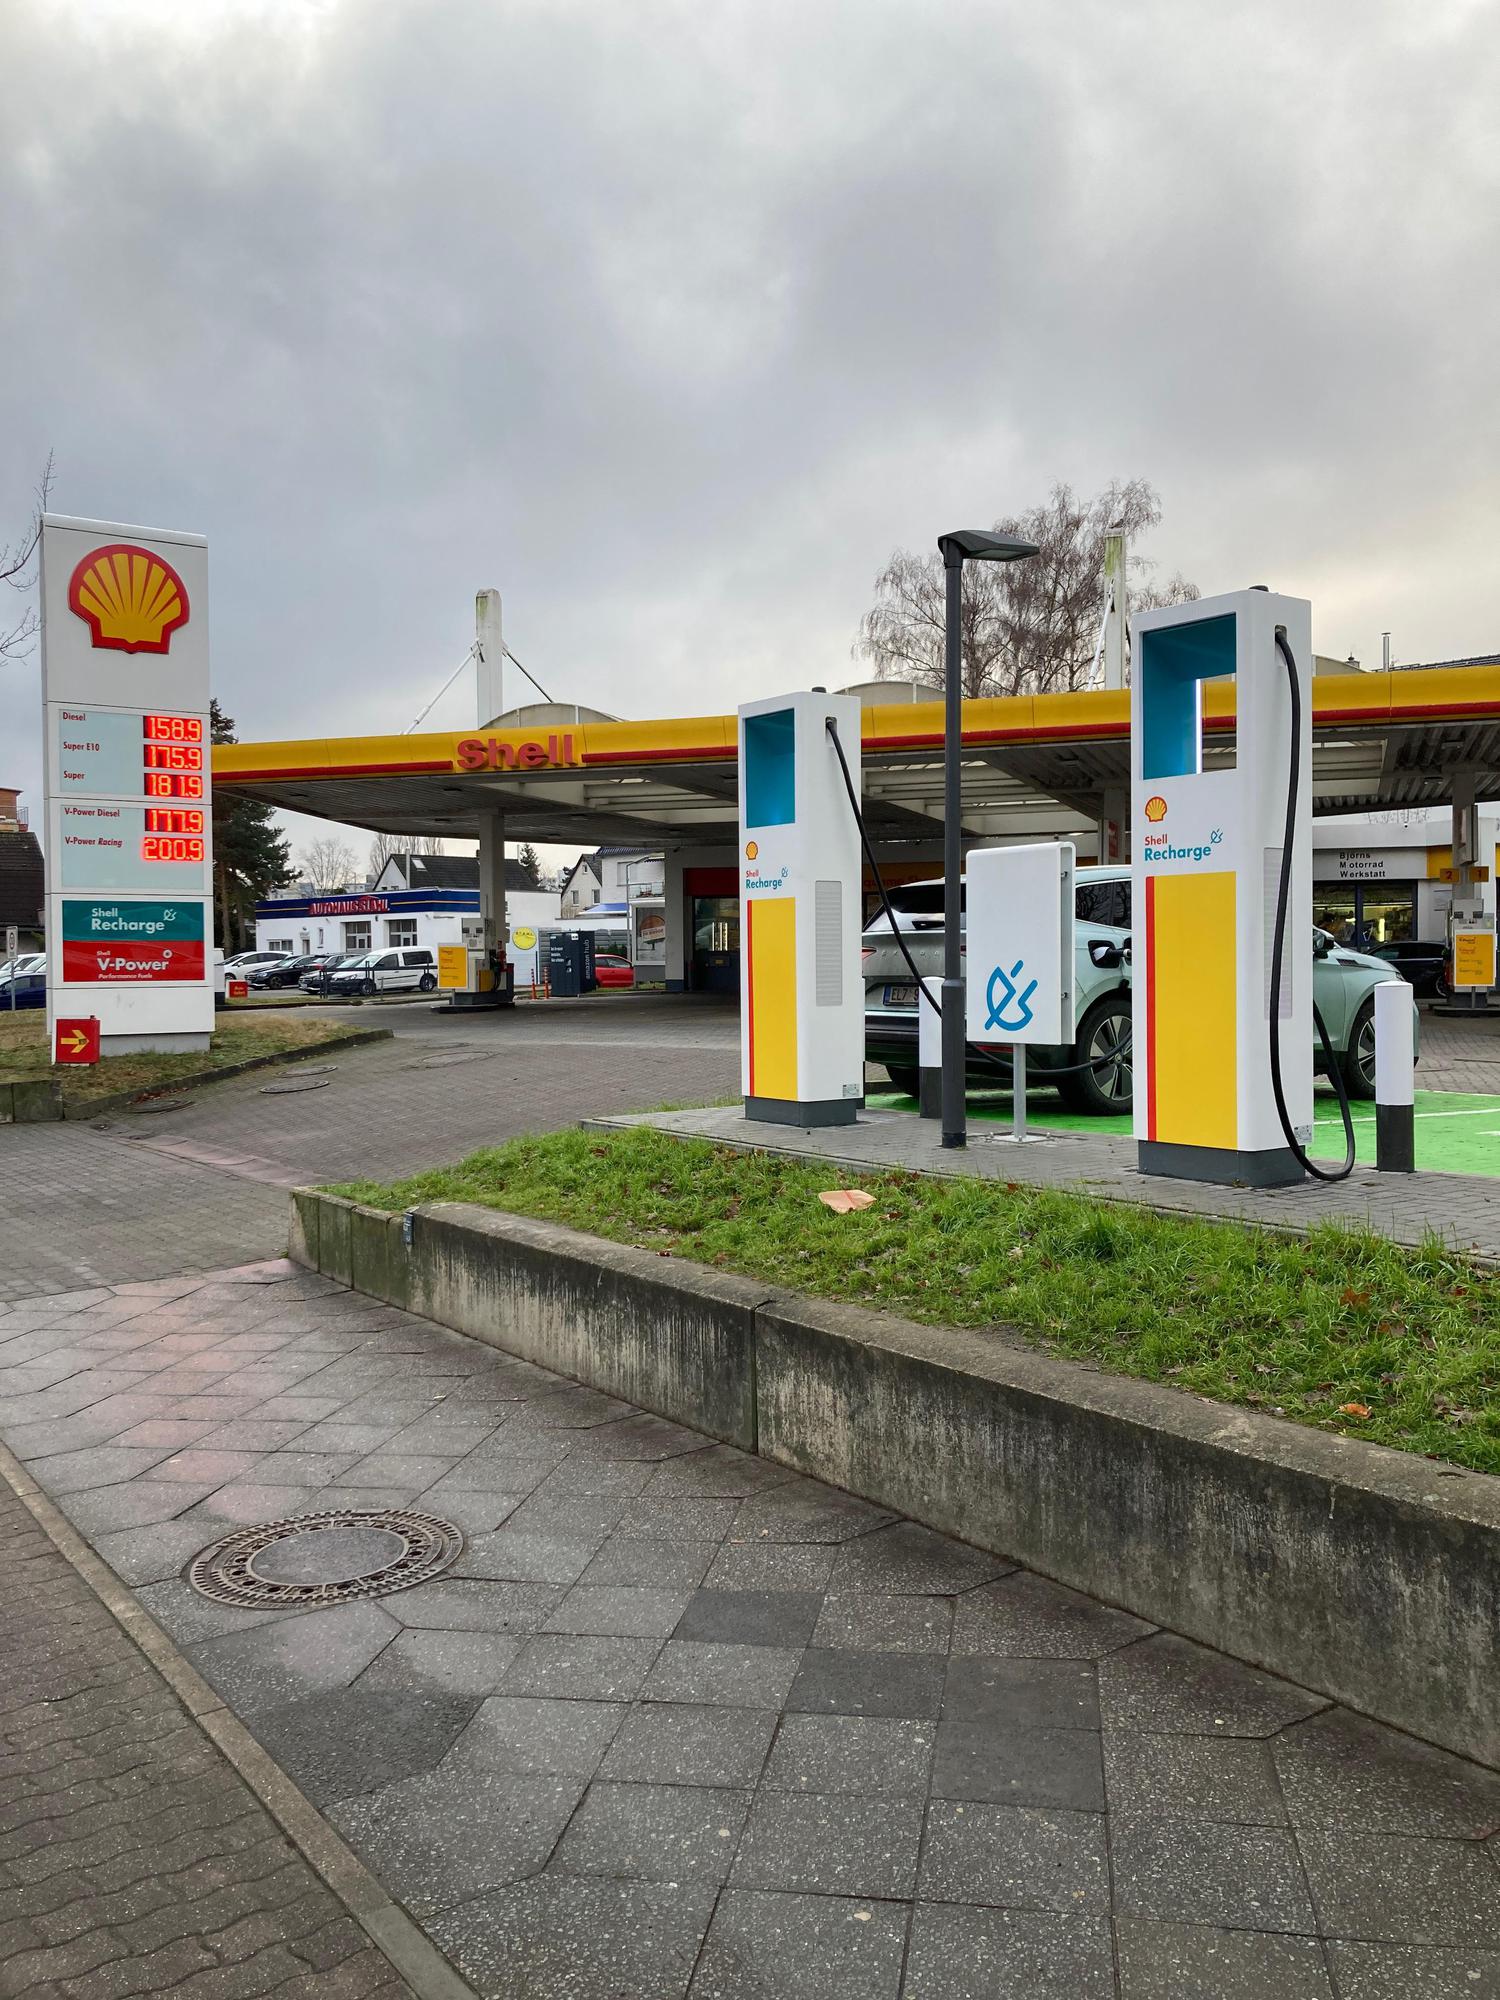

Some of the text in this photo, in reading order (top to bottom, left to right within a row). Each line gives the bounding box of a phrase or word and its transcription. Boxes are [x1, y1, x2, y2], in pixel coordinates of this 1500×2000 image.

[62, 712, 202, 741] Diesel 158.9
[63, 741, 202, 769] Super E10 175.9
[457, 734, 573, 769] Shell
[63, 771, 85, 780] Super
[64, 808, 203, 833] V-Power Diesel 177.9
[1144, 833, 1168, 846] Shell
[65, 837, 203, 861] V-Power Racing 200.9
[1144, 845, 1212, 861] Recharge
[746, 869, 759, 878] Shell
[1339, 870, 1386, 878] Werkstatt
[745, 877, 783, 890] Recharge
[91, 908, 118, 918] Shell
[91, 918, 165, 934] Recharge
[96, 958, 169, 971] V-Power
[891, 987, 908, 1001] EL7
